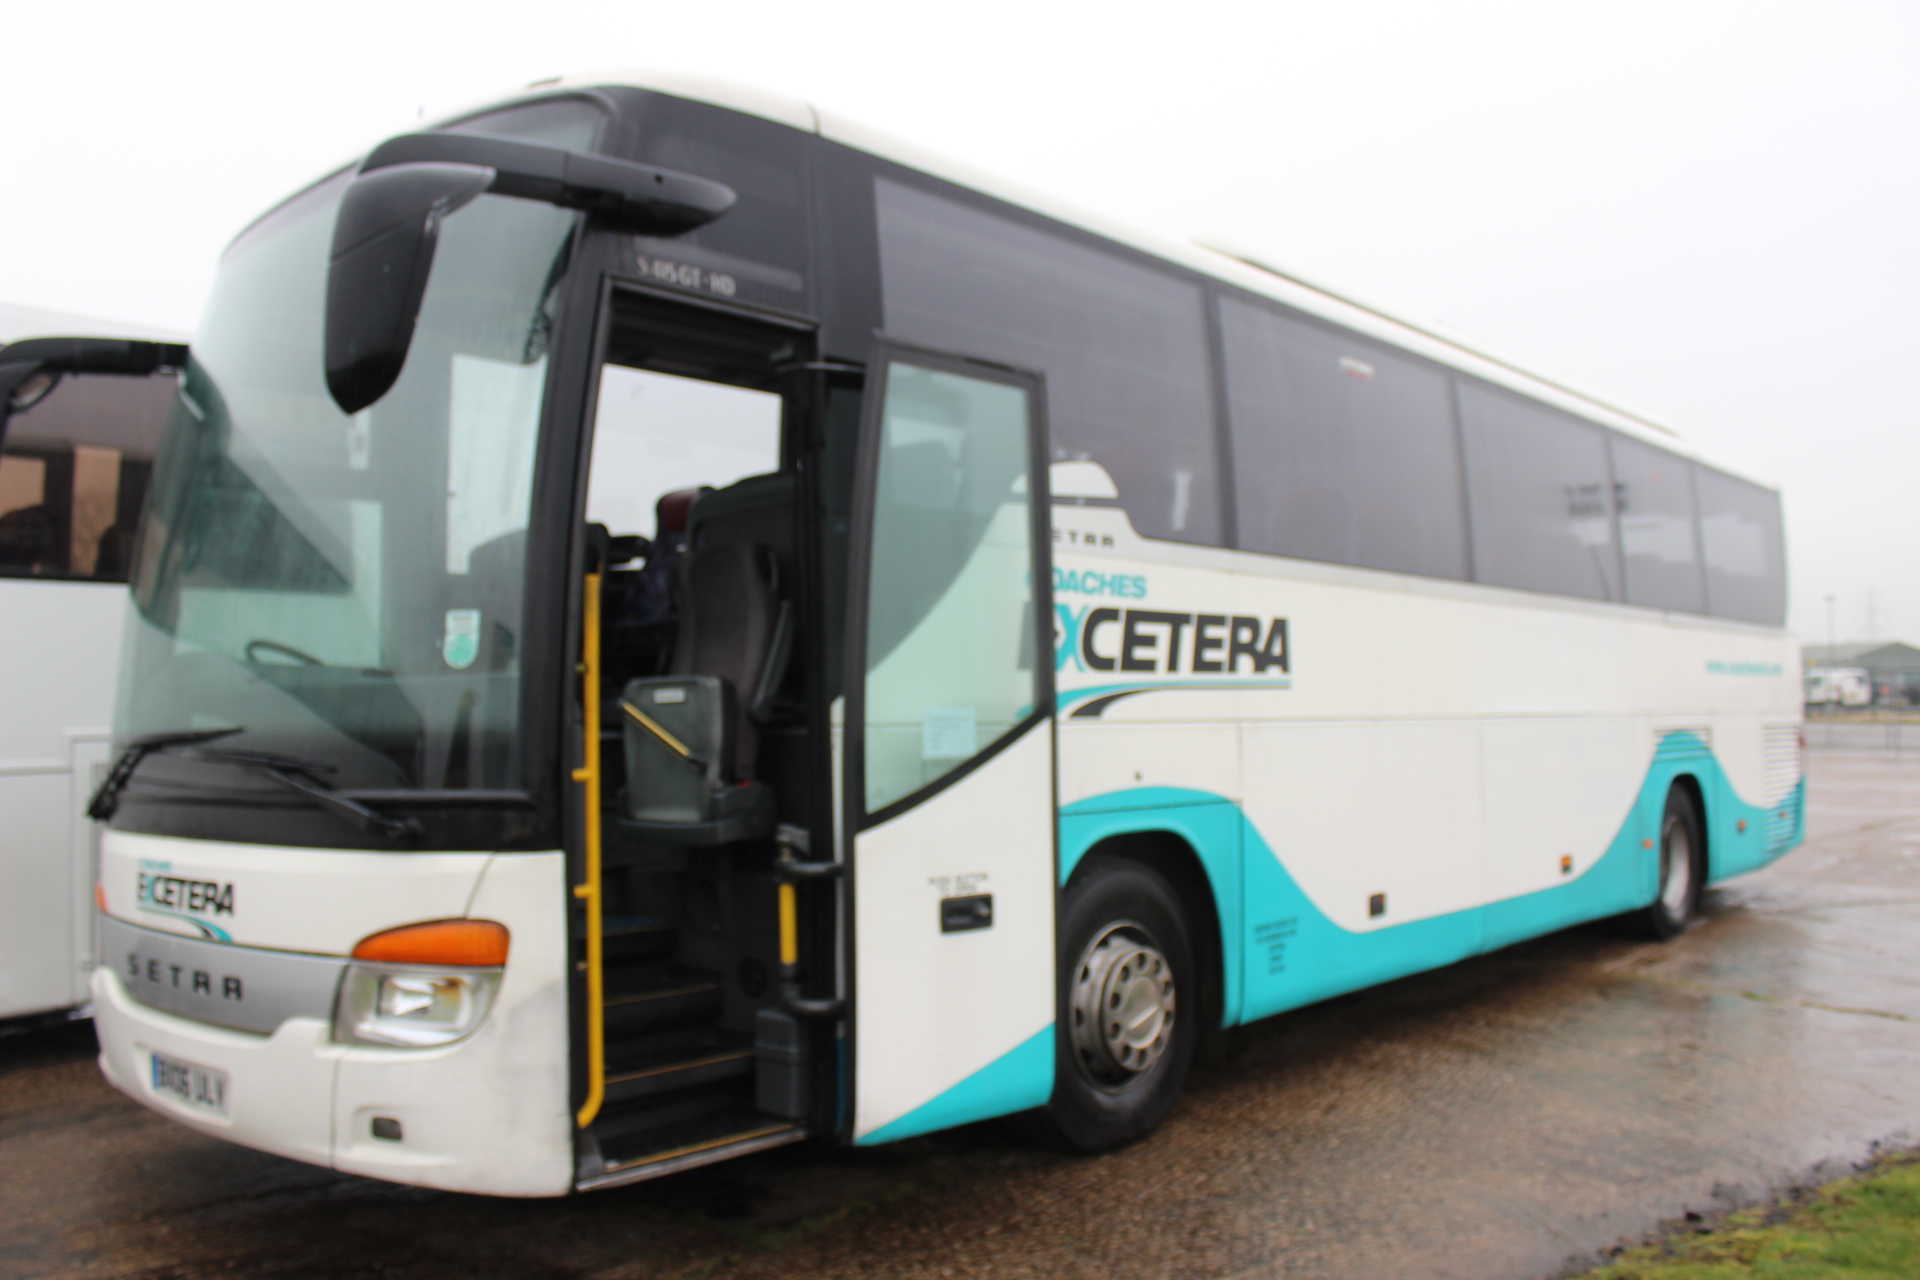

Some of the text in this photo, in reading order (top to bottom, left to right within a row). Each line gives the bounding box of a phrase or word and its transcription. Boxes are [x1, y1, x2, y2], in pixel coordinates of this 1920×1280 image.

[1051, 529, 1114, 547] ETRA
[138, 872, 233, 916] EXCETERA
[127, 953, 242, 1001] SETRA
